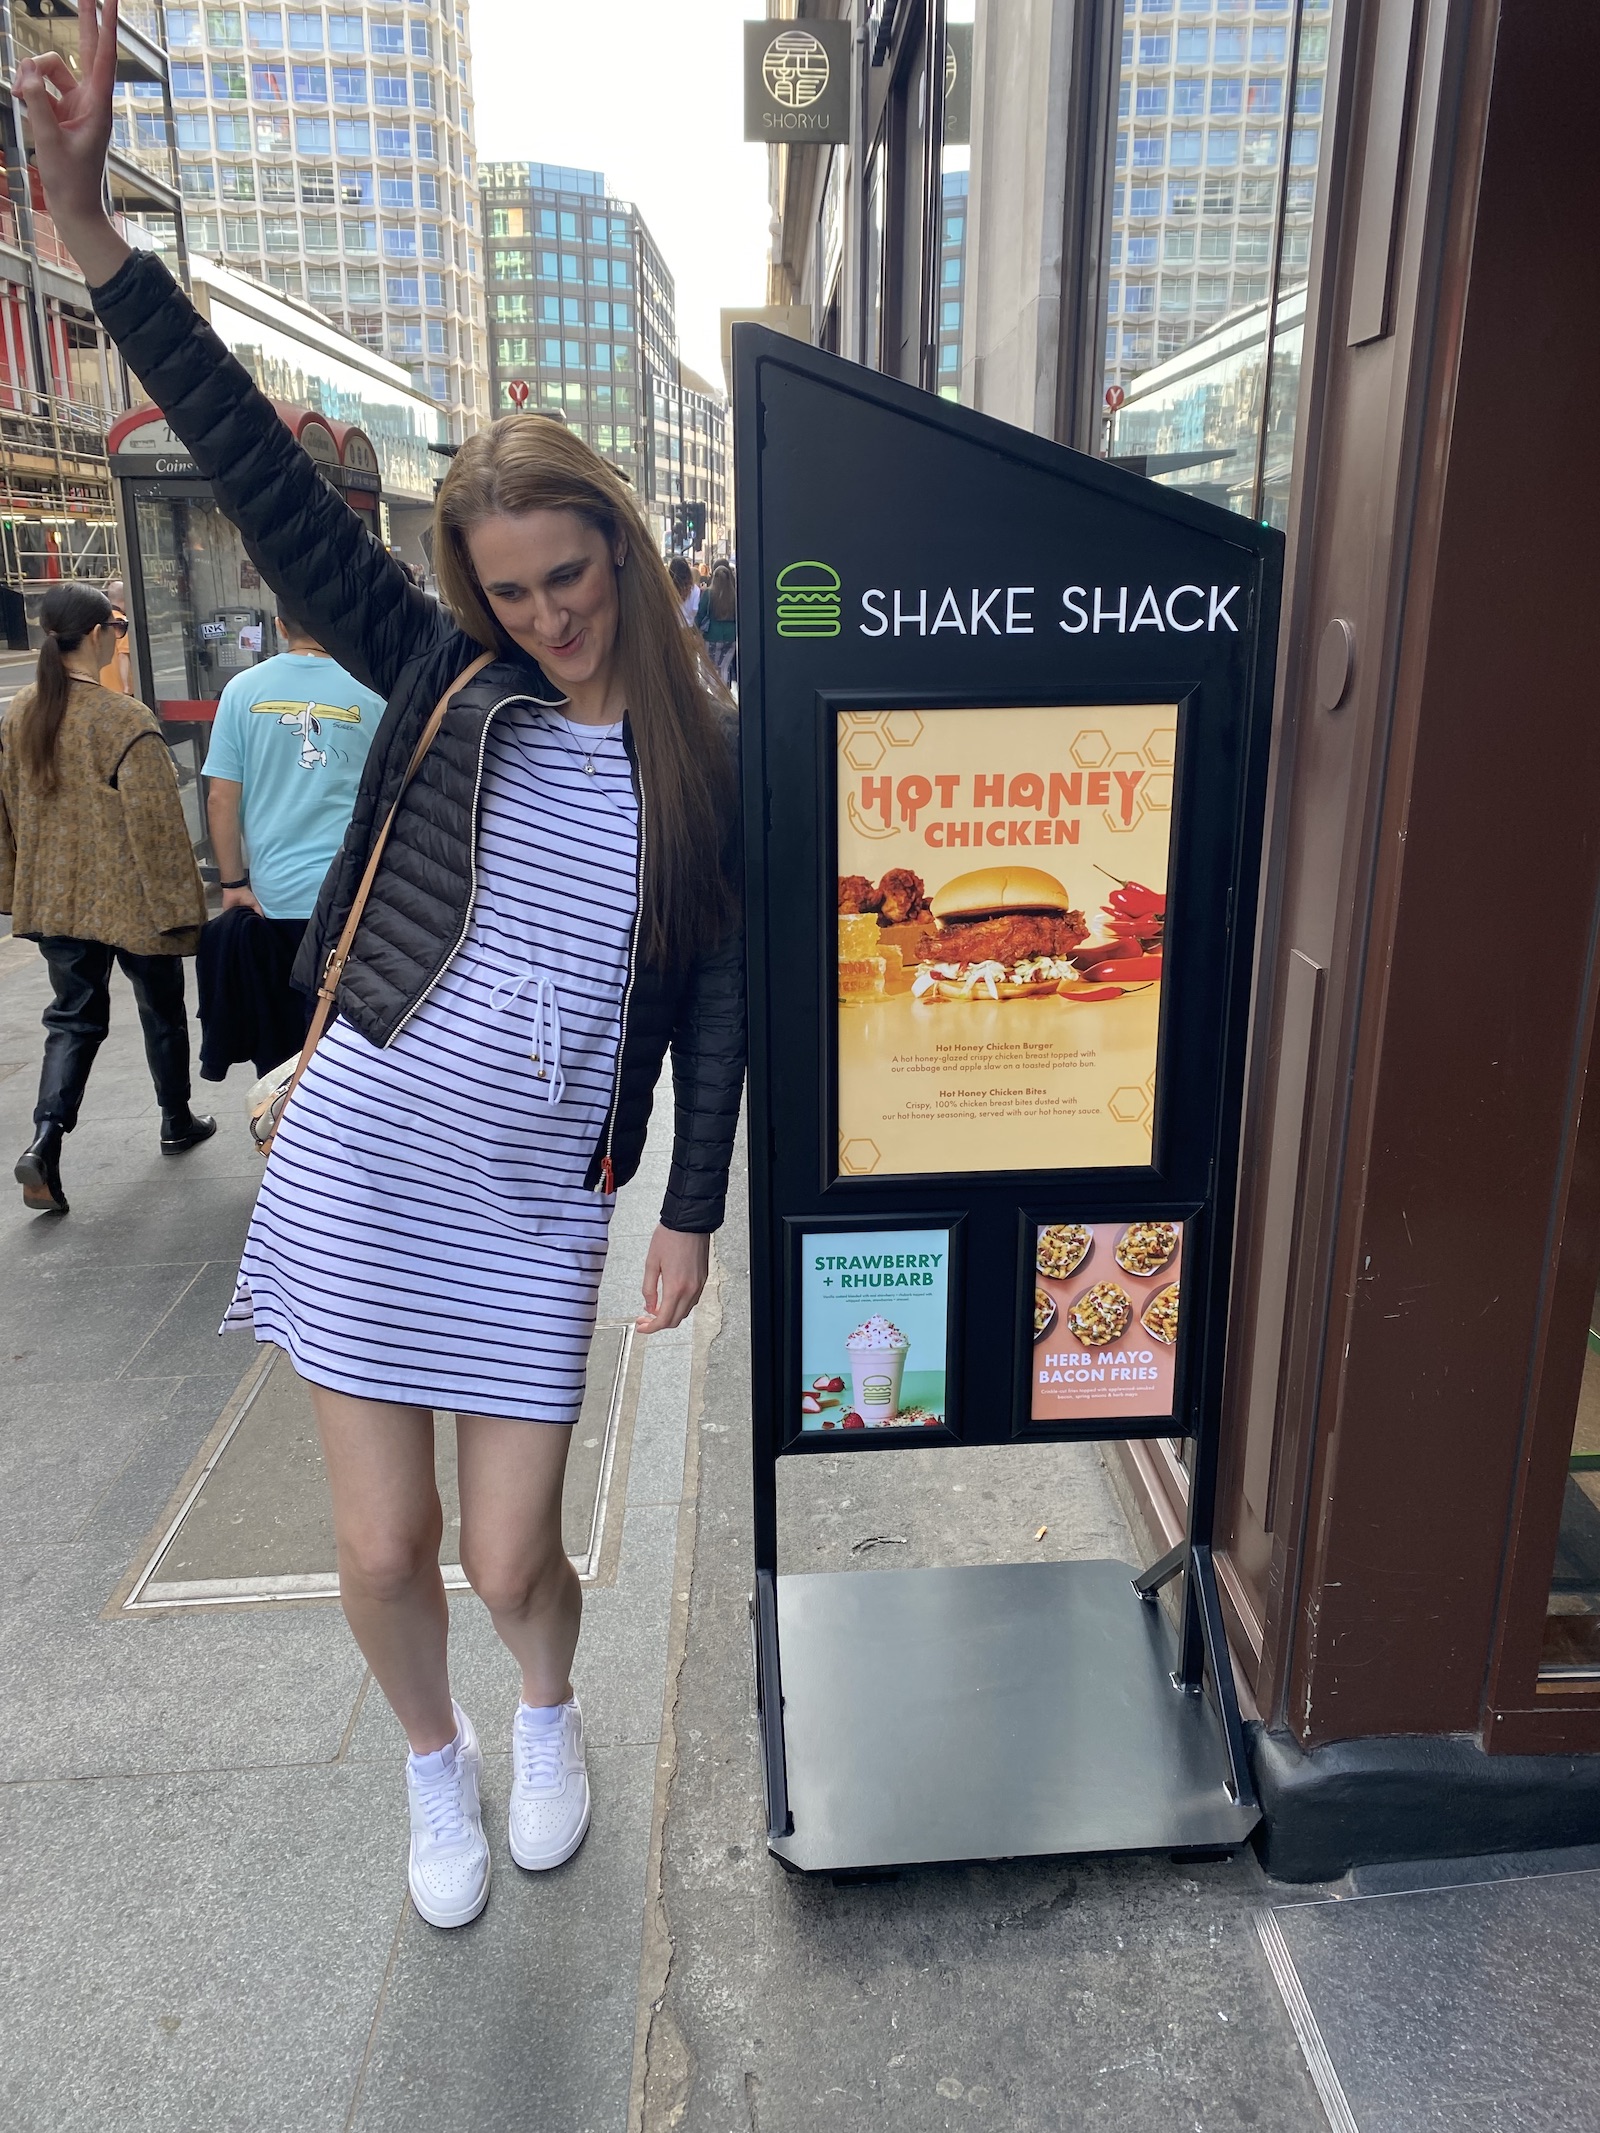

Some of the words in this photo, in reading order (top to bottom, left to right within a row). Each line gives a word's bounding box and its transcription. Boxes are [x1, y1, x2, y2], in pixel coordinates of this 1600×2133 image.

[762, 112, 830, 129] SHORYU
[512, 383, 524, 399] Y
[155, 458, 194, 473] Coins
[858, 586, 1036, 637] SHAKE
[1058, 584, 1241, 634] SHACK
[861, 774, 960, 832] HOT
[973, 770, 1146, 826] HONEY
[924, 819, 1080, 849] CHICKEN
[936, 1044, 952, 1052] Hot
[954, 1044, 984, 1052] Honey
[1023, 1042, 1054, 1051] Burger
[900, 1054, 912, 1062] hot
[915, 1054, 968, 1063] honey-glazed
[970, 1054, 993, 1062] crispy
[994, 1052, 1023, 1060] chicken
[1025, 1051, 1049, 1059] breast
[1051, 1050, 1078, 1059] topped
[1080, 1050, 1096, 1058] with
[906, 1064, 940, 1073] cabbage
[960, 1063, 982, 1072] apple
[984, 1062, 1001, 1070] slaw
[1022, 1061, 1050, 1069] toasted
[1052, 1061, 1077, 1070] potato
[939, 1090, 956, 1098] Hot
[957, 1090, 987, 1098] Honey
[989, 1088, 1023, 1096] Chicken
[905, 1101, 932, 1110] Crispy,
[935, 1100, 958, 1108] 100%
[959, 1099, 988, 1107] chicken
[989, 1098, 1013, 1107] breast
[1015, 1098, 1032, 1106] bites
[1034, 1097, 1060, 1105] dusted
[1061, 1097, 1078, 1105] with
[897, 1112, 910, 1120] hot
[911, 1112, 935, 1120] honey
[937, 1111, 976, 1120] seasoning,
[979, 1109, 1004, 1117] served
[1039, 1108, 1051, 1116] hot
[1053, 1107, 1076, 1116] honey
[815, 1253, 943, 1271] STRAWBERRY
[823, 1276, 834, 1286] +
[841, 1272, 934, 1288] RHUBARB
[1045, 1353, 1092, 1367] HERB
[1097, 1350, 1153, 1365] MAYO
[1039, 1368, 1105, 1384] BACON
[1111, 1366, 1158, 1381] FRIES
